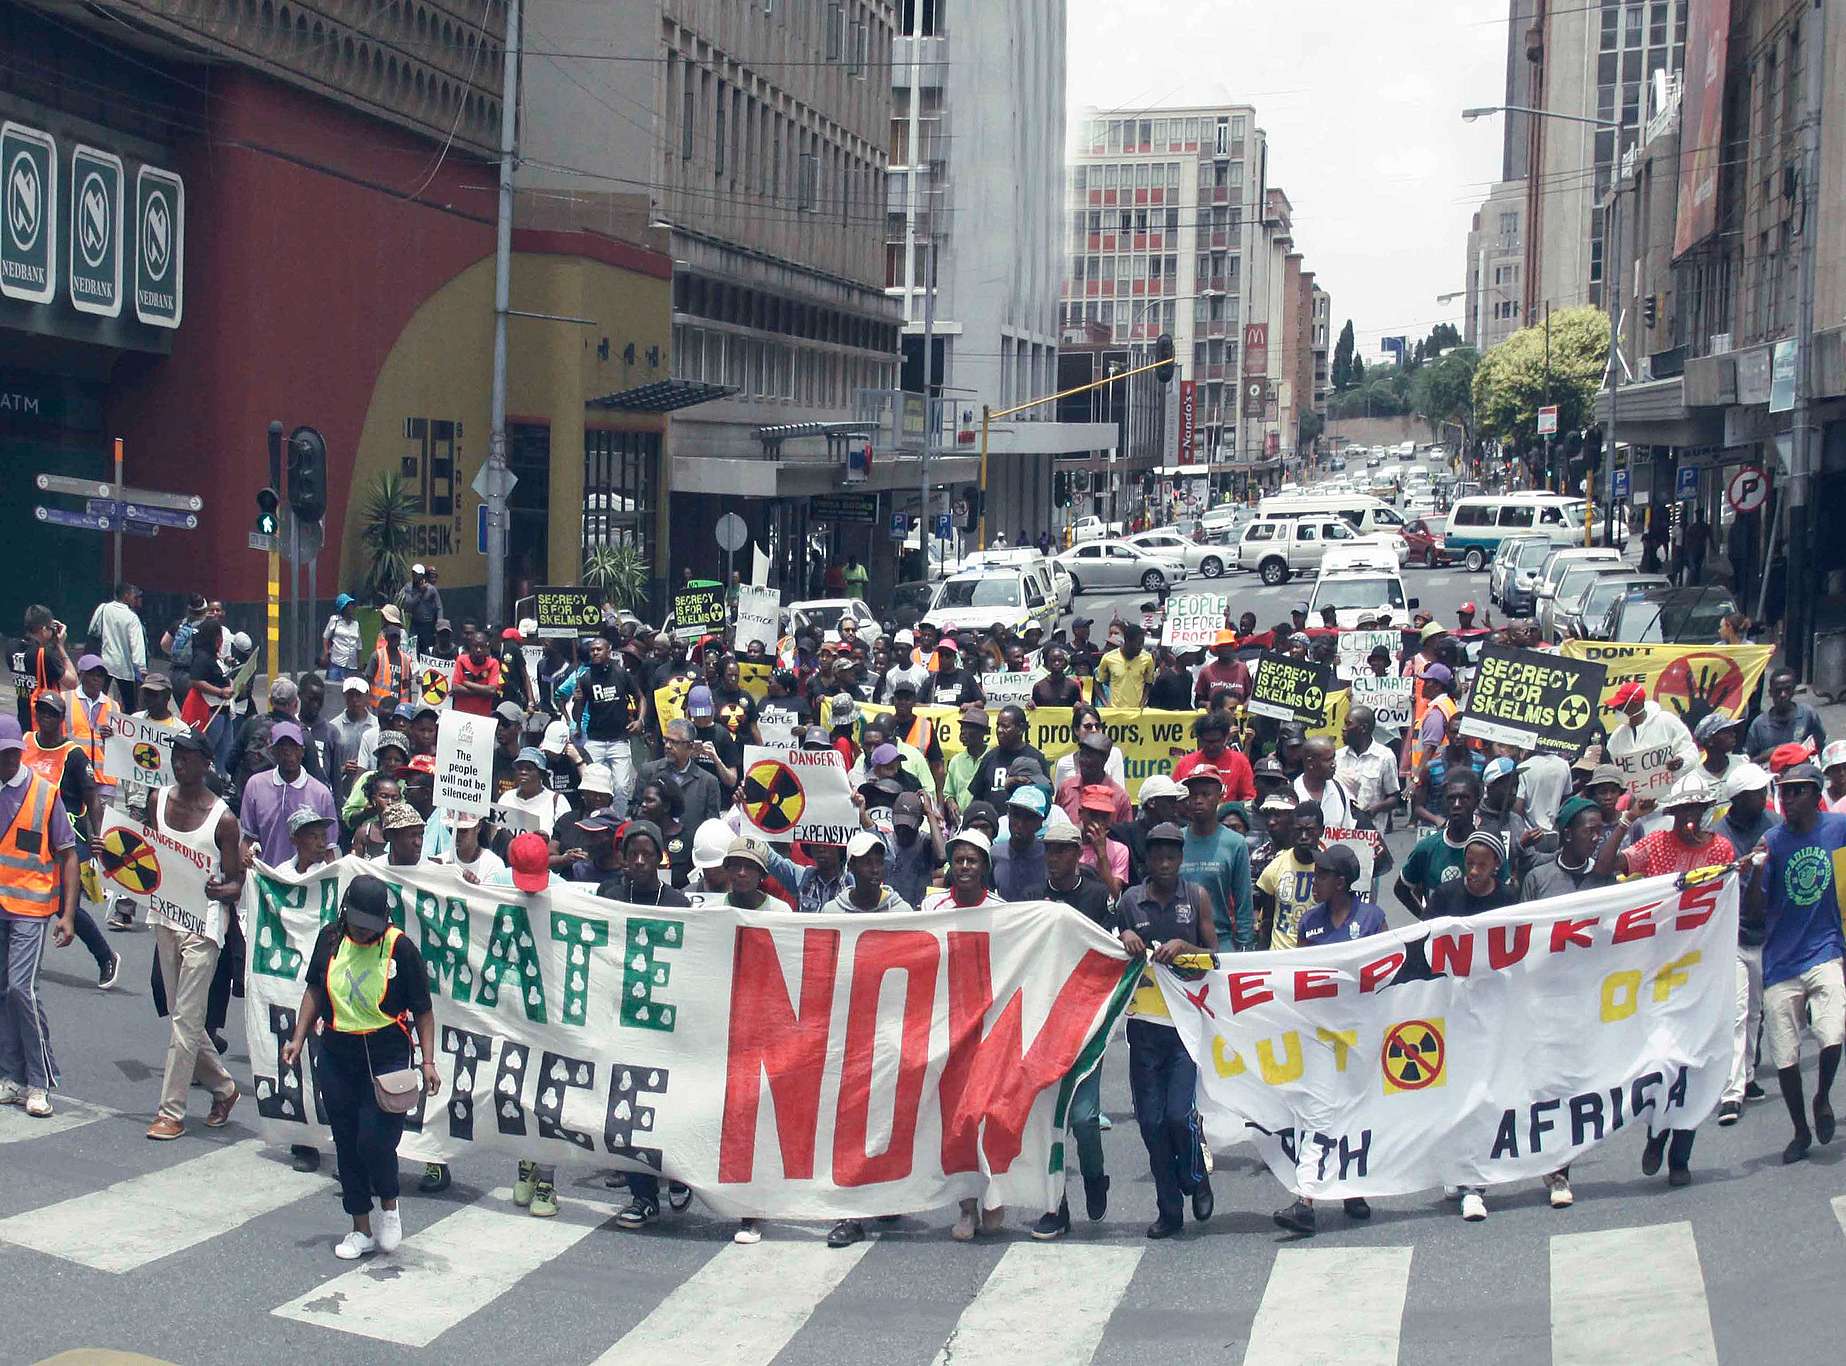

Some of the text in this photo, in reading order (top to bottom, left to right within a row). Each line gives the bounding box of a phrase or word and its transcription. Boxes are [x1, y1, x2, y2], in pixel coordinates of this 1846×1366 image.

[2, 259, 45, 284] NEDBANK
[73, 275, 113, 298] NEDBANK
[138, 289, 174, 310] NEDBANK
[0, 393, 39, 414] ATM
[1183, 391, 1193, 449] Nando's
[1616, 472, 1626, 484] P
[1683, 470, 1694, 484] P
[1742, 478, 1759, 502] P
[406, 523, 454, 556] ISSIK
[537, 594, 588, 605] SECRECY
[675, 592, 714, 607] SECRECY
[675, 603, 703, 616] IS FOR
[1167, 596, 1225, 616] PEOPLE
[539, 605, 573, 615] IS FOR
[540, 614, 583, 625] SKELMS
[677, 612, 711, 625] SKELMS
[741, 612, 774, 625] JUSTICE
[1173, 616, 1222, 630] BEFORE
[1341, 631, 1402, 651] CLIMATE
[1586, 646, 1654, 660] DON'T
[983, 674, 1036, 686] CLIMATE
[1261, 660, 1316, 684] SECRECY
[1481, 657, 1579, 691] SECRECY
[1603, 673, 1647, 687] UKE
[1258, 673, 1270, 686] IS
[1271, 676, 1296, 692] FOR
[1354, 678, 1411, 691] CLIMATE
[1475, 675, 1542, 704] IS FOR
[987, 692, 1031, 702] JUSTIC
[1255, 685, 1303, 707] SKELMS
[1359, 693, 1404, 709] JUSTICE
[1471, 694, 1555, 726] SKELMS
[110, 715, 136, 738] NO
[1152, 723, 1184, 742] we
[457, 749, 471, 761] The
[449, 763, 478, 776] people
[440, 773, 456, 785] will
[457, 777, 473, 788] not
[475, 780, 486, 791] be
[442, 787, 482, 803] silenced!
[143, 825, 213, 873] DANGEROUS!
[150, 894, 207, 937] EXPENSIVE
[253, 873, 685, 1032] CMATE
[1186, 880, 1724, 1018] KEEP NUKES
[1600, 950, 1701, 1023] OF
[718, 926, 1130, 1187] NOW
[1212, 1027, 1358, 1085] OUT
[255, 1003, 669, 1172] JTICE
[1490, 1066, 1688, 1159] AFRICA
